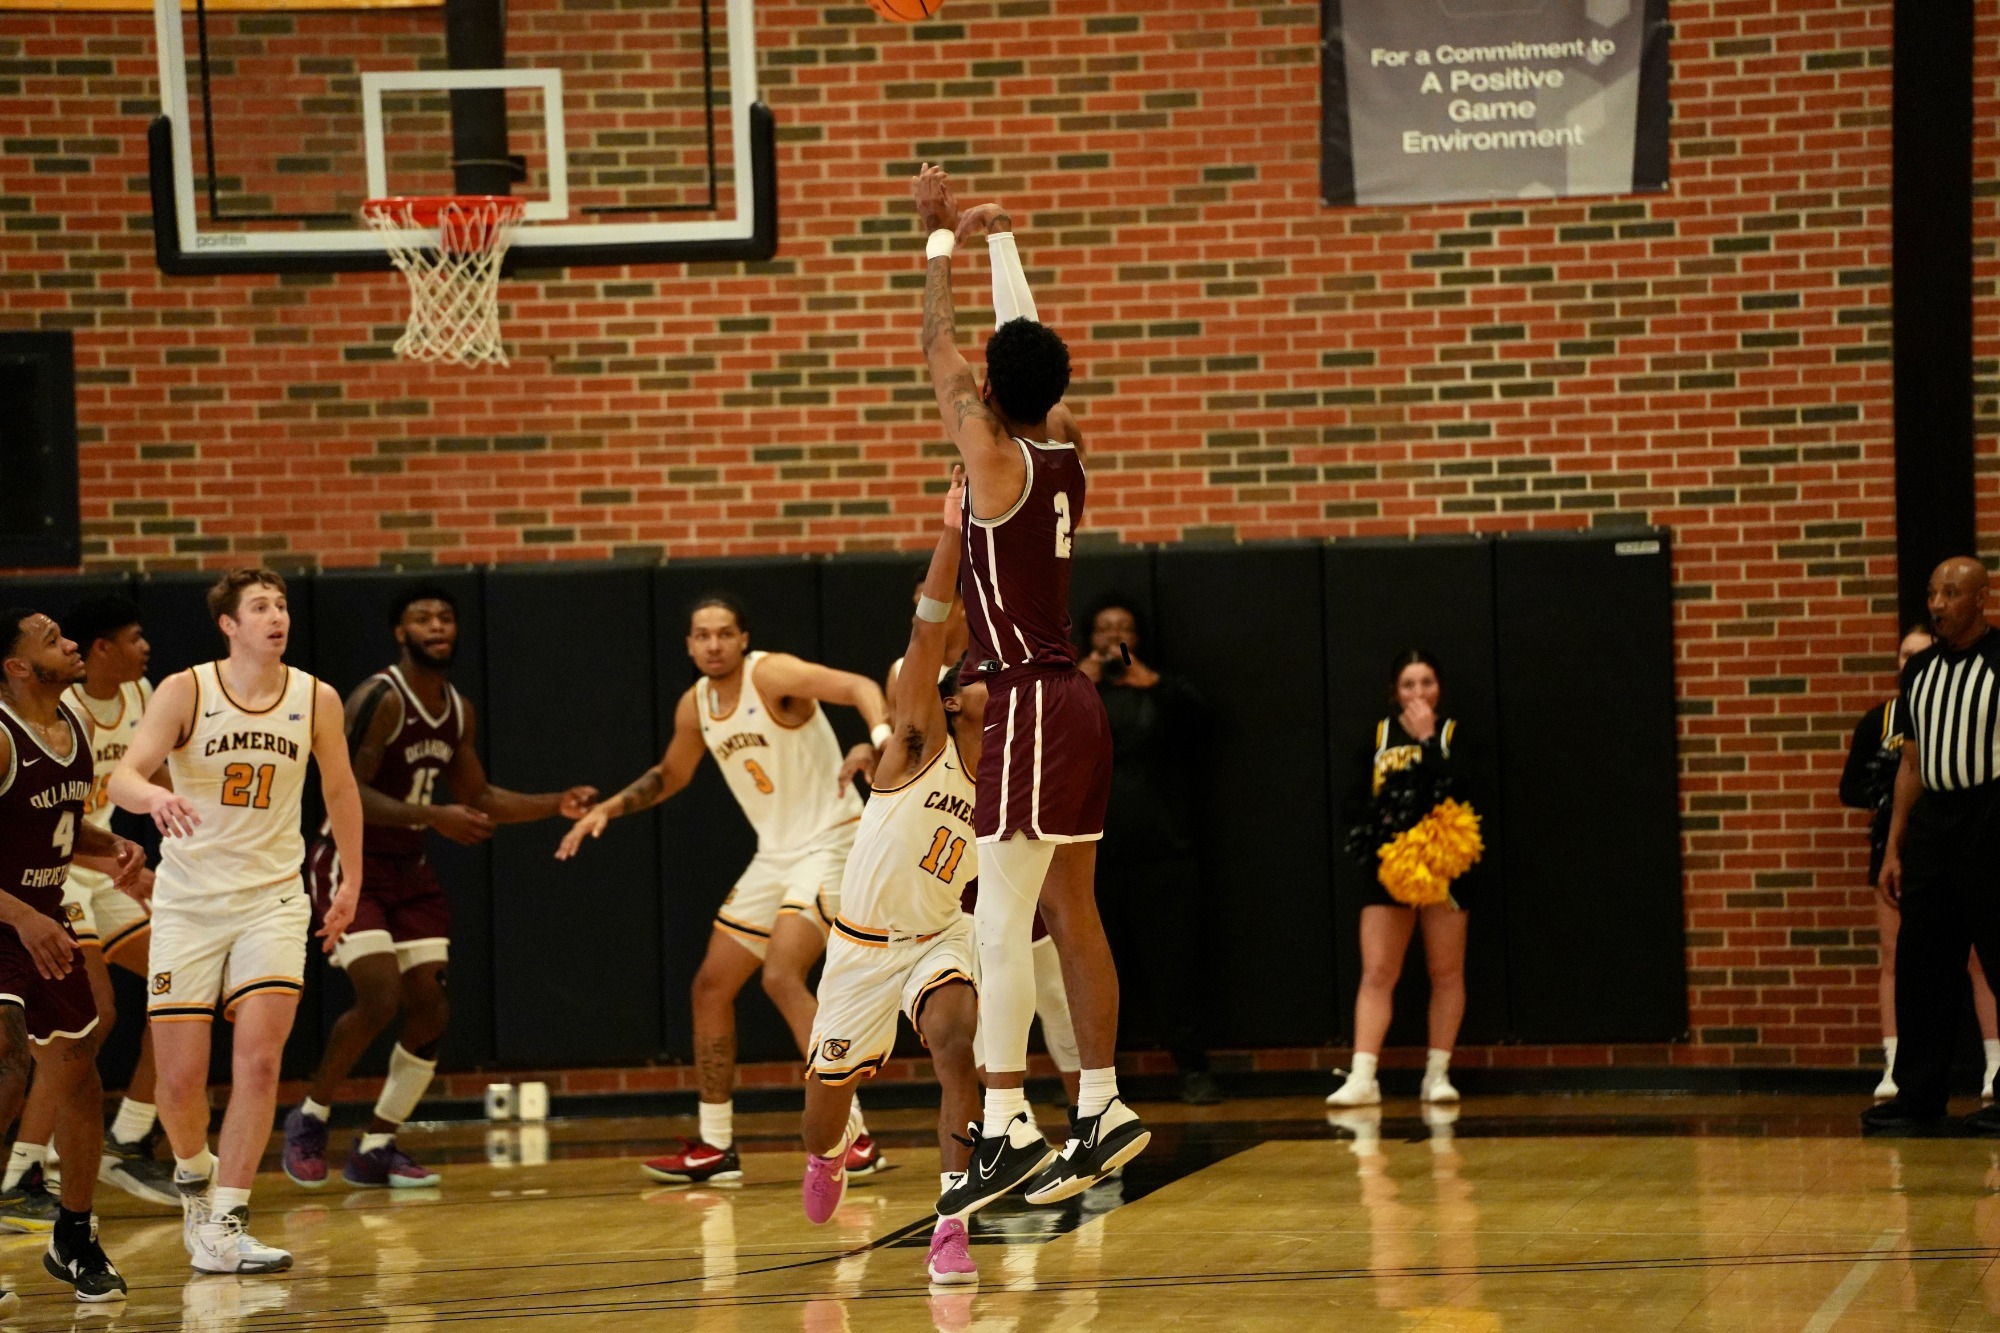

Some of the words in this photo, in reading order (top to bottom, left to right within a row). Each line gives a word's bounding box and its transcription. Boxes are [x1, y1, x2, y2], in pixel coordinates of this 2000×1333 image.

[1370, 47, 1411, 67] For
[1415, 49, 1431, 65] a
[1436, 39, 1584, 64] Commitment
[1591, 38, 1615, 56] to
[1421, 71, 1443, 94] A
[1450, 67, 1564, 92] Positive
[1448, 99, 1536, 122] Game
[1403, 125, 1583, 152] Environment
[1054, 491, 1072, 559] 2
[204, 731, 299, 762] CAMERON
[221, 762, 276, 809] 21
[405, 767, 440, 807] 15
[744, 758, 774, 795] 3
[52, 810, 74, 858] 4
[919, 825, 967, 884] 11
